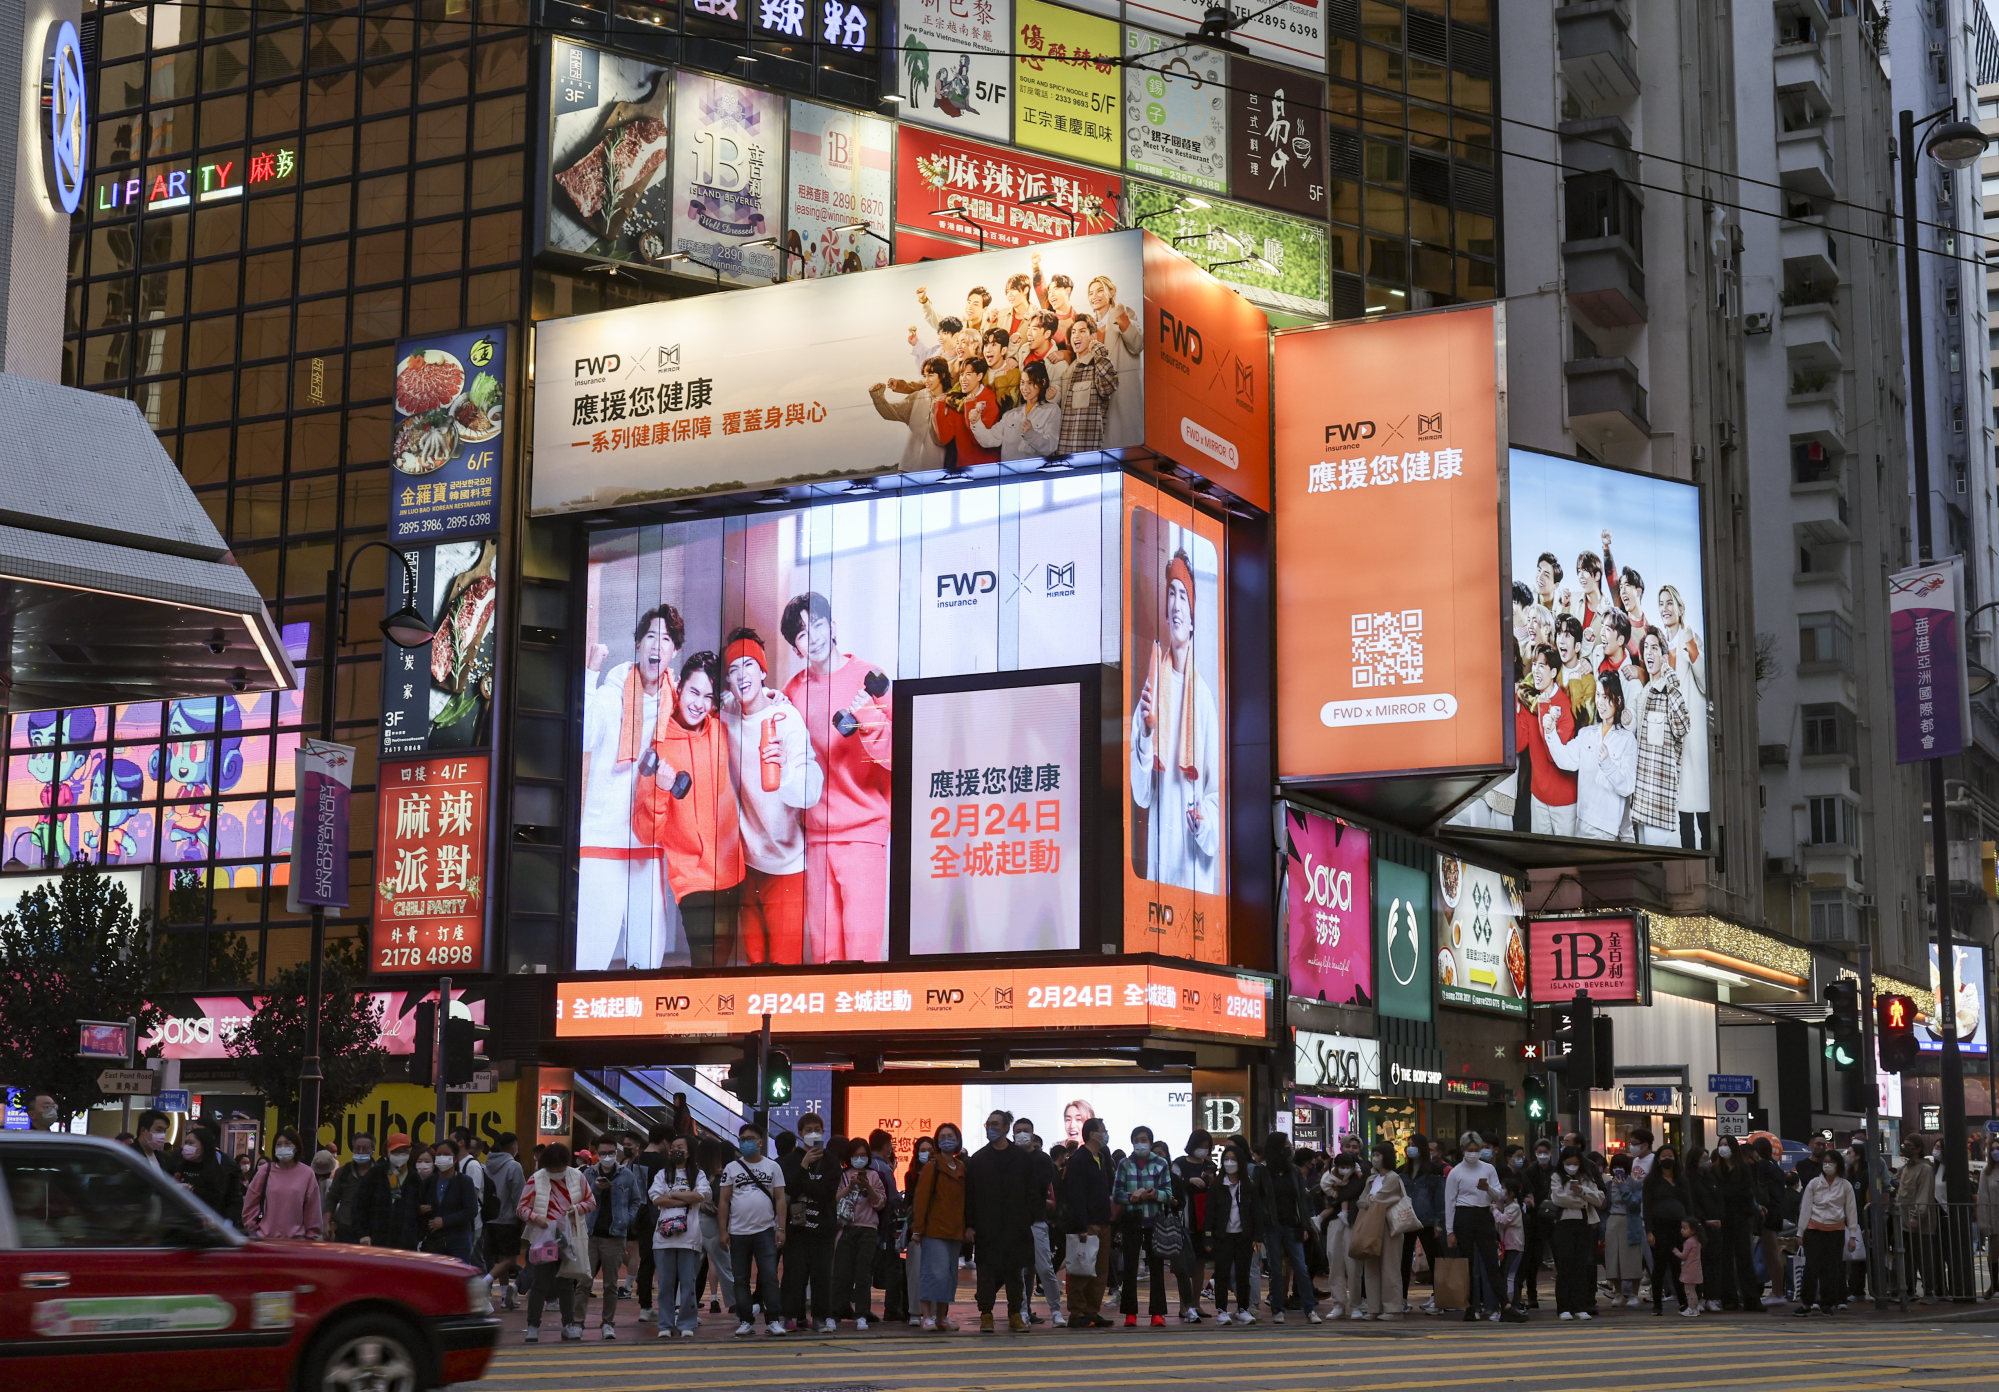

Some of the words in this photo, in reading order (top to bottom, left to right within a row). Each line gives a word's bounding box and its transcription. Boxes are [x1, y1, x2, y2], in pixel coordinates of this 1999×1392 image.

[904, 24, 917, 33] New
[918, 27, 935, 38] Paris
[936, 32, 972, 47] Vietnamese
[922, 15, 993, 43] 正宗越南餐廳
[1289, 22, 1318, 39] 6398
[1128, 32, 1160, 51] 5/F
[565, 88, 585, 103] 3F
[976, 80, 1007, 104] 5/F
[1020, 75, 1035, 84] SOUR
[1036, 79, 1048, 87] AND
[1049, 82, 1065, 91] SPICY
[1066, 86, 1089, 97] NOODLE
[1055, 93, 1072, 105] 2333
[1073, 98, 1089, 108] 9693
[1091, 93, 1116, 114] 5/F
[1023, 106, 1113, 143] 正宗重慶風味
[1143, 140, 1159, 150] Meet
[1161, 145, 1173, 154] You
[1175, 149, 1210, 163] Restaurant
[690, 186, 721, 199] ISLAND
[947, 153, 1083, 214] 麻辣派對
[1169, 171, 1194, 184] 2387
[1196, 178, 1220, 191] 9388
[833, 191, 856, 210] 2890
[860, 197, 884, 216] 6870
[1309, 185, 1324, 201] 5F
[701, 215, 720, 230] Well
[722, 223, 753, 237] Dressed
[946, 193, 1006, 224] CHILI
[1009, 207, 1081, 238] PARTY
[718, 247, 744, 262] 2890
[749, 255, 775, 268] 6870
[1160, 308, 1203, 365] FWD
[575, 353, 621, 378] FWD
[1160, 351, 1190, 375] insurance
[574, 376, 606, 387] insurance
[572, 377, 713, 427] 應援您健康
[571, 416, 712, 453] 一系列健康保障
[722, 400, 827, 436] 覆蓋身與心
[1325, 420, 1376, 443] FWD
[1186, 425, 1199, 442] FWD
[1204, 435, 1226, 457] MIRROR
[1325, 442, 1360, 452] insurance
[467, 451, 495, 471] 6/F
[1307, 447, 1464, 494] 應援您健康
[400, 482, 447, 507] 金羅寶
[449, 486, 492, 501] 韓國料理
[432, 504, 453, 512] KOREAN
[399, 521, 420, 535] 2895
[446, 515, 468, 529] 2895
[469, 513, 491, 527] 6398
[937, 570, 996, 597] FWD
[937, 597, 978, 609] insurance
[1914, 616, 1935, 750] 香港亞洲國際都會
[385, 711, 405, 727] 3F
[1333, 707, 1363, 719] FWD
[1365, 709, 1372, 717] x
[1375, 703, 1426, 716] MIRROR
[929, 762, 1061, 799] 應援您健康
[318, 784, 326, 820] ASIA'S
[322, 786, 335, 838] HONG
[930, 799, 1061, 838] 2月24日
[317, 827, 325, 863] WORLD
[930, 838, 1061, 879] 全城起動
[315, 868, 323, 896] CITY
[321, 844, 334, 899] KONG
[393, 899, 425, 917] CHILI
[427, 898, 467, 915] PARTY
[1149, 901, 1174, 926] FWD
[1316, 911, 1341, 948] 莎莎
[381, 948, 421, 966] 2178
[425, 946, 473, 965] 4898
[1552, 932, 1606, 980] iB
[1607, 931, 1623, 979] 金百利
[1584, 980, 1625, 989] BEVERLEY
[572, 996, 643, 1019] 全城起動
[655, 996, 690, 1011] FWD
[748, 991, 825, 1016] 2月24日
[834, 989, 912, 1013] 全城起動
[926, 988, 964, 1005] FWD
[926, 1004, 953, 1012] insurance
[1027, 984, 1112, 1009] 2月24日
[1123, 983, 1176, 1010] 全城起動
[1182, 988, 1200, 1005] FWD
[1226, 995, 1262, 1020] 2月24日
[1400, 1068, 1411, 1081] THE
[1412, 1069, 1427, 1084] BODY
[1428, 1071, 1442, 1085] SHOP
[805, 1099, 822, 1114] 3F
[878, 1118, 902, 1129] FWD
[1720, 1116, 1730, 1124] 24
[1732, 1116, 1744, 1124] hrs
[1722, 1125, 1742, 1133] 全日
